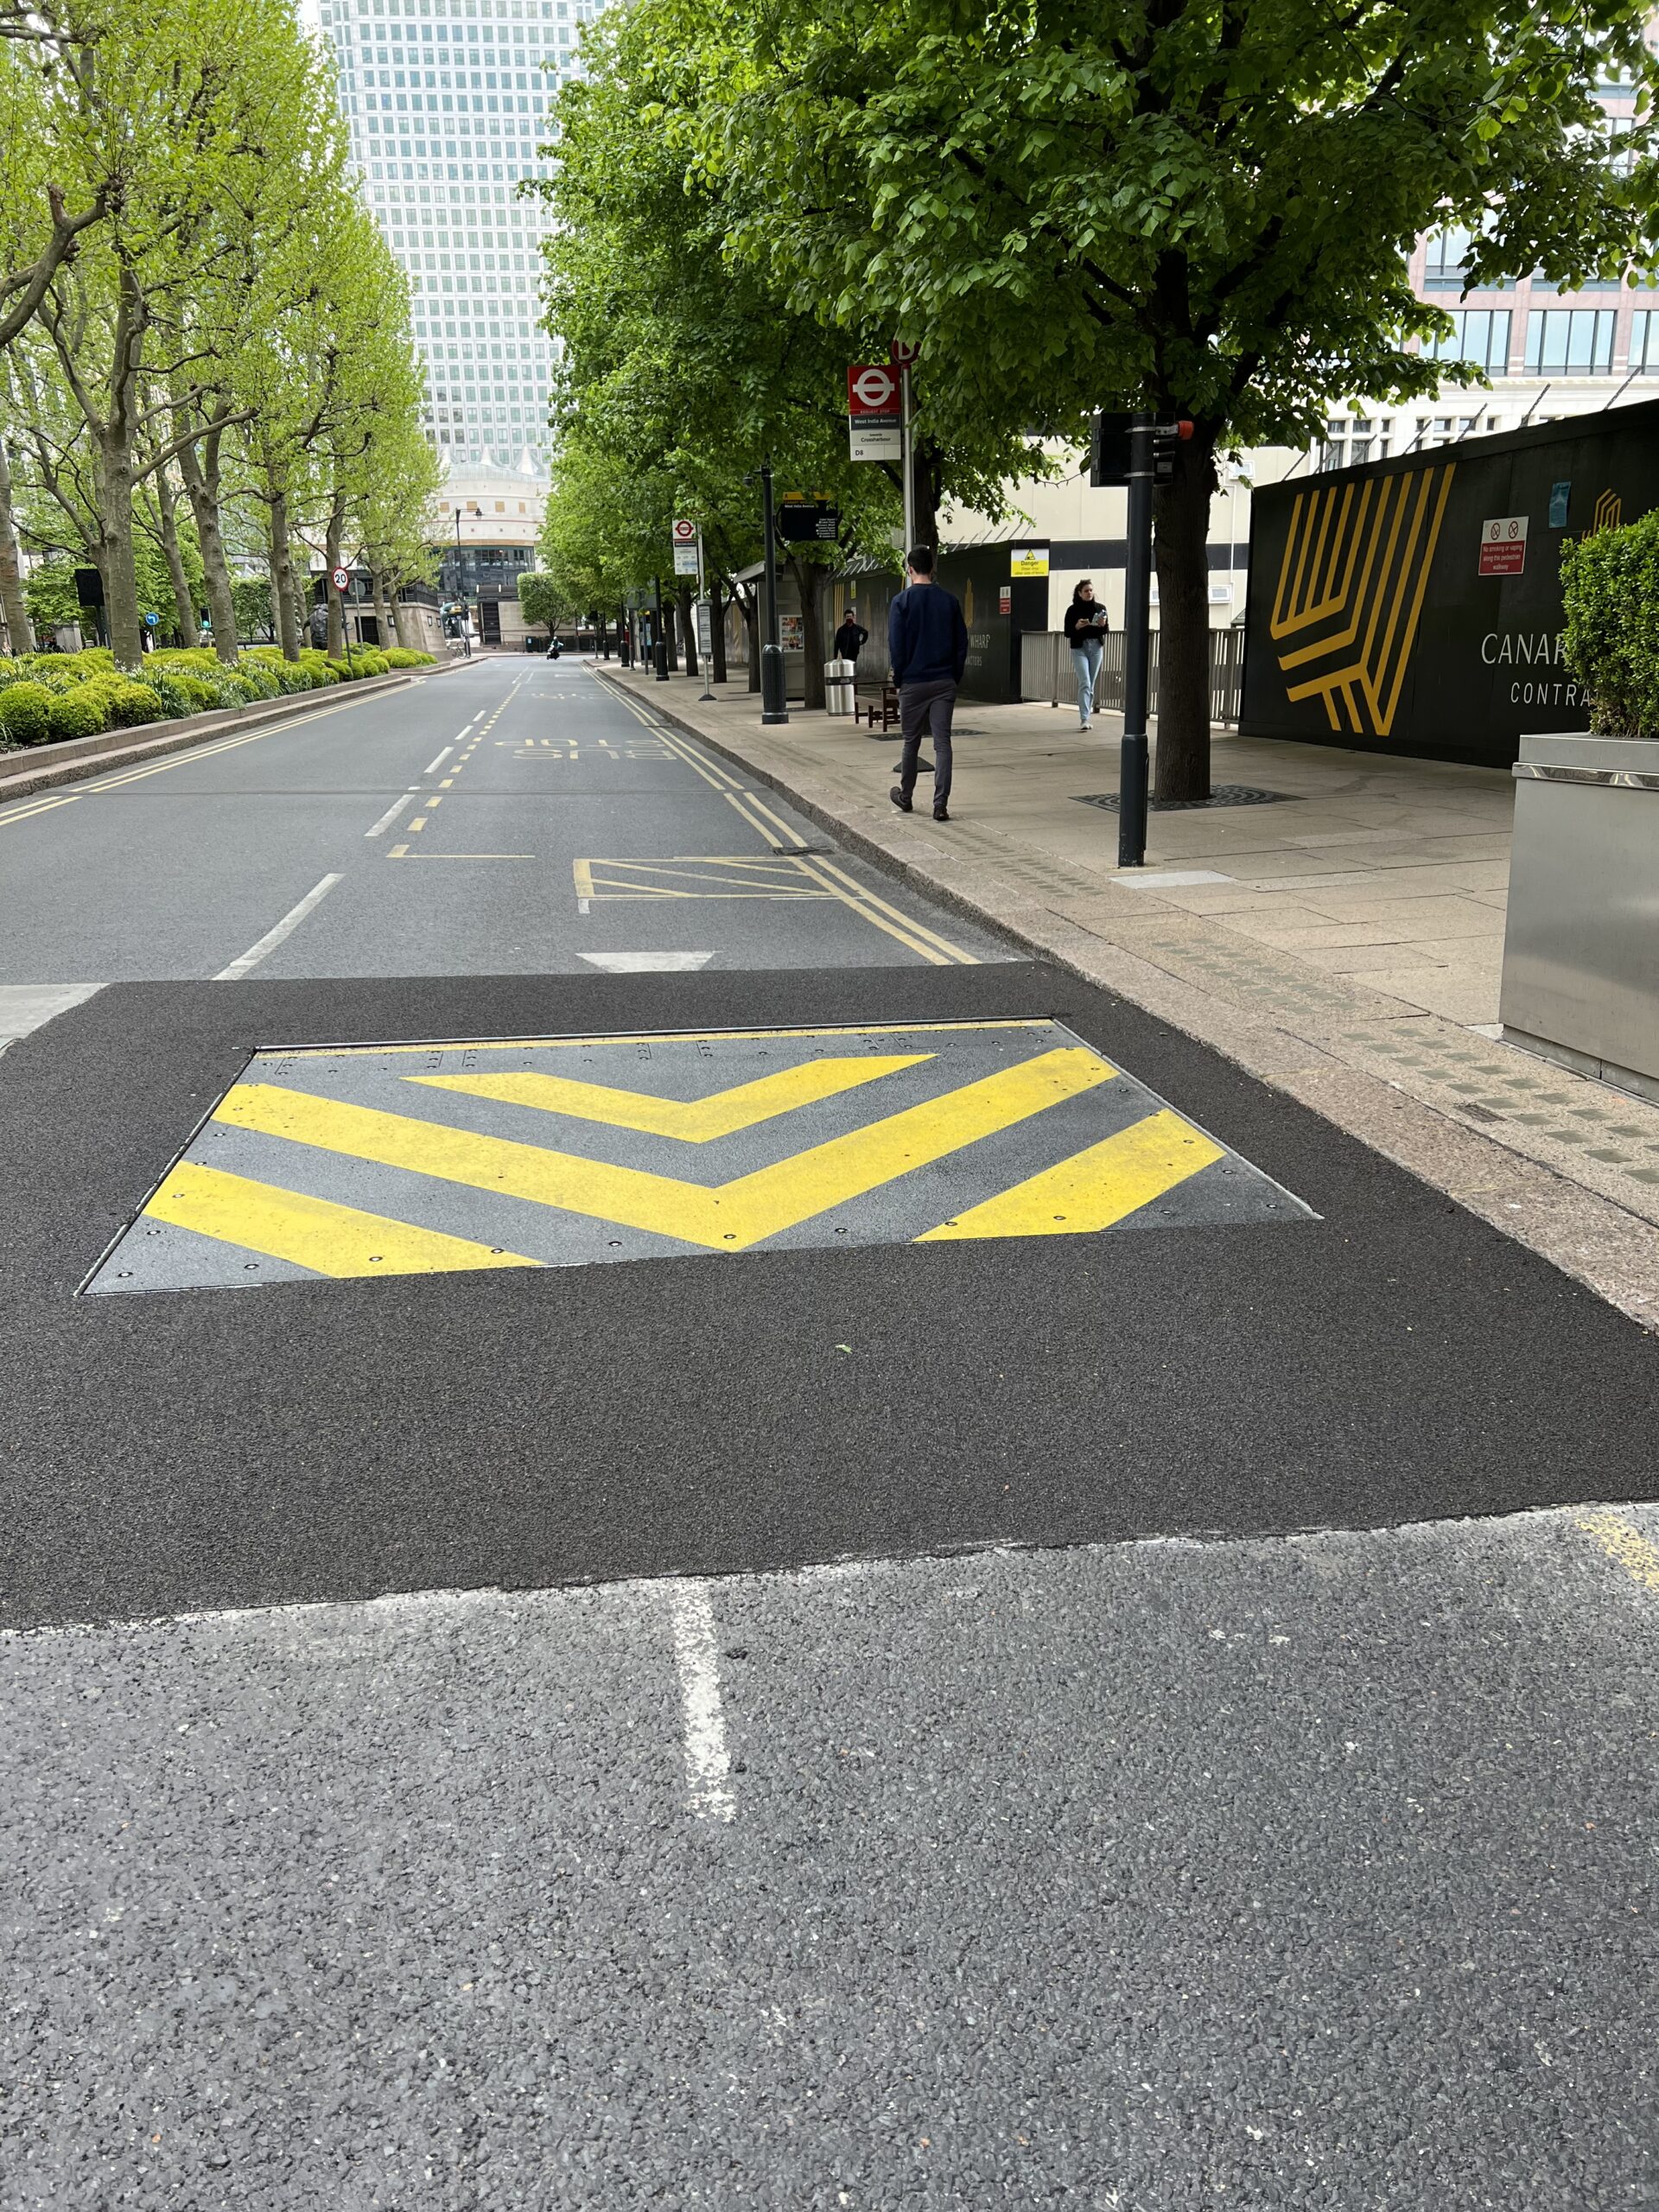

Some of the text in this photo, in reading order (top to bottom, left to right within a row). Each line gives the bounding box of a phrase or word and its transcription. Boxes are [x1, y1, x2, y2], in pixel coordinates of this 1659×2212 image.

[334, 574, 346, 583] 20
[1481, 632, 1567, 664] CANAR
[1510, 682, 1592, 707] CONTRA
